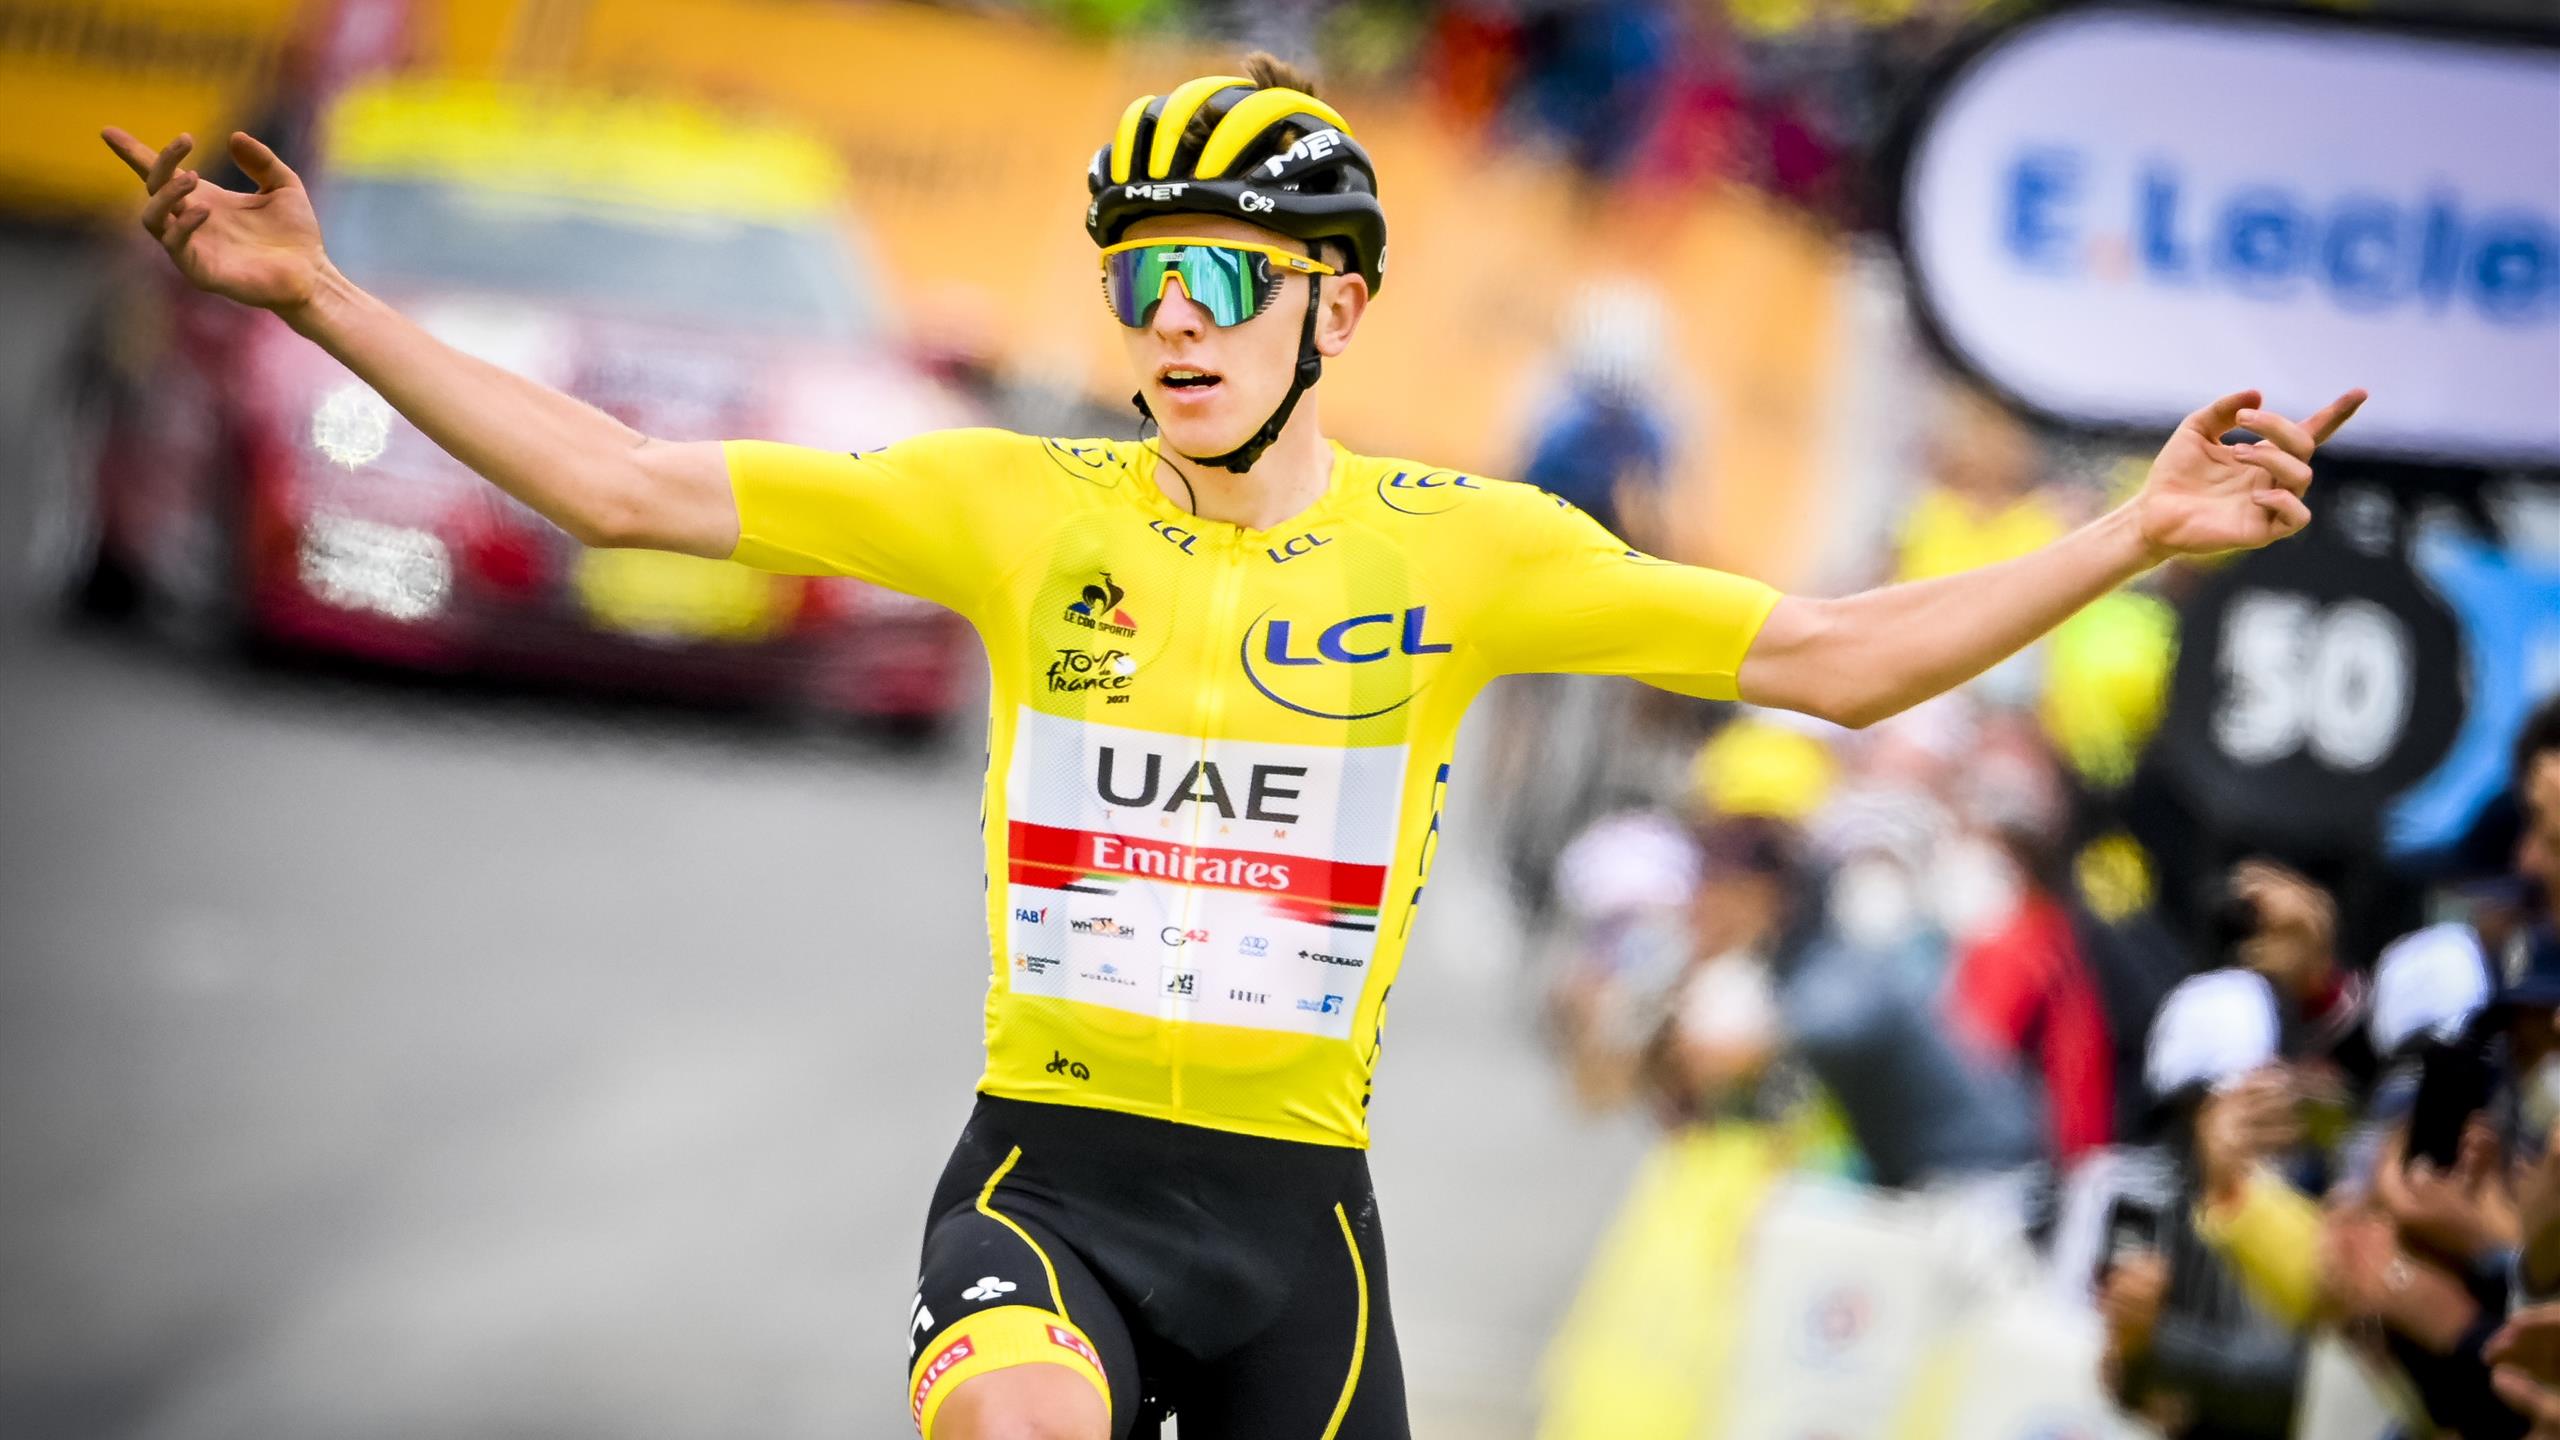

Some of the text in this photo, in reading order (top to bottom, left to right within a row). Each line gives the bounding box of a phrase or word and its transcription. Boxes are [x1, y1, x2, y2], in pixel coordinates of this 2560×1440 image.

[1264, 129, 1341, 177] MET
[1125, 182, 1190, 201] MET
[1391, 471, 1481, 490] LCL
[1149, 520, 1198, 556] LCL
[1267, 533, 1333, 564] LCL
[1265, 605, 1453, 666] LCL
[2212, 592, 2414, 772] 50
[1097, 746, 1309, 825] UAE
[1092, 835, 1291, 890] Emirates
